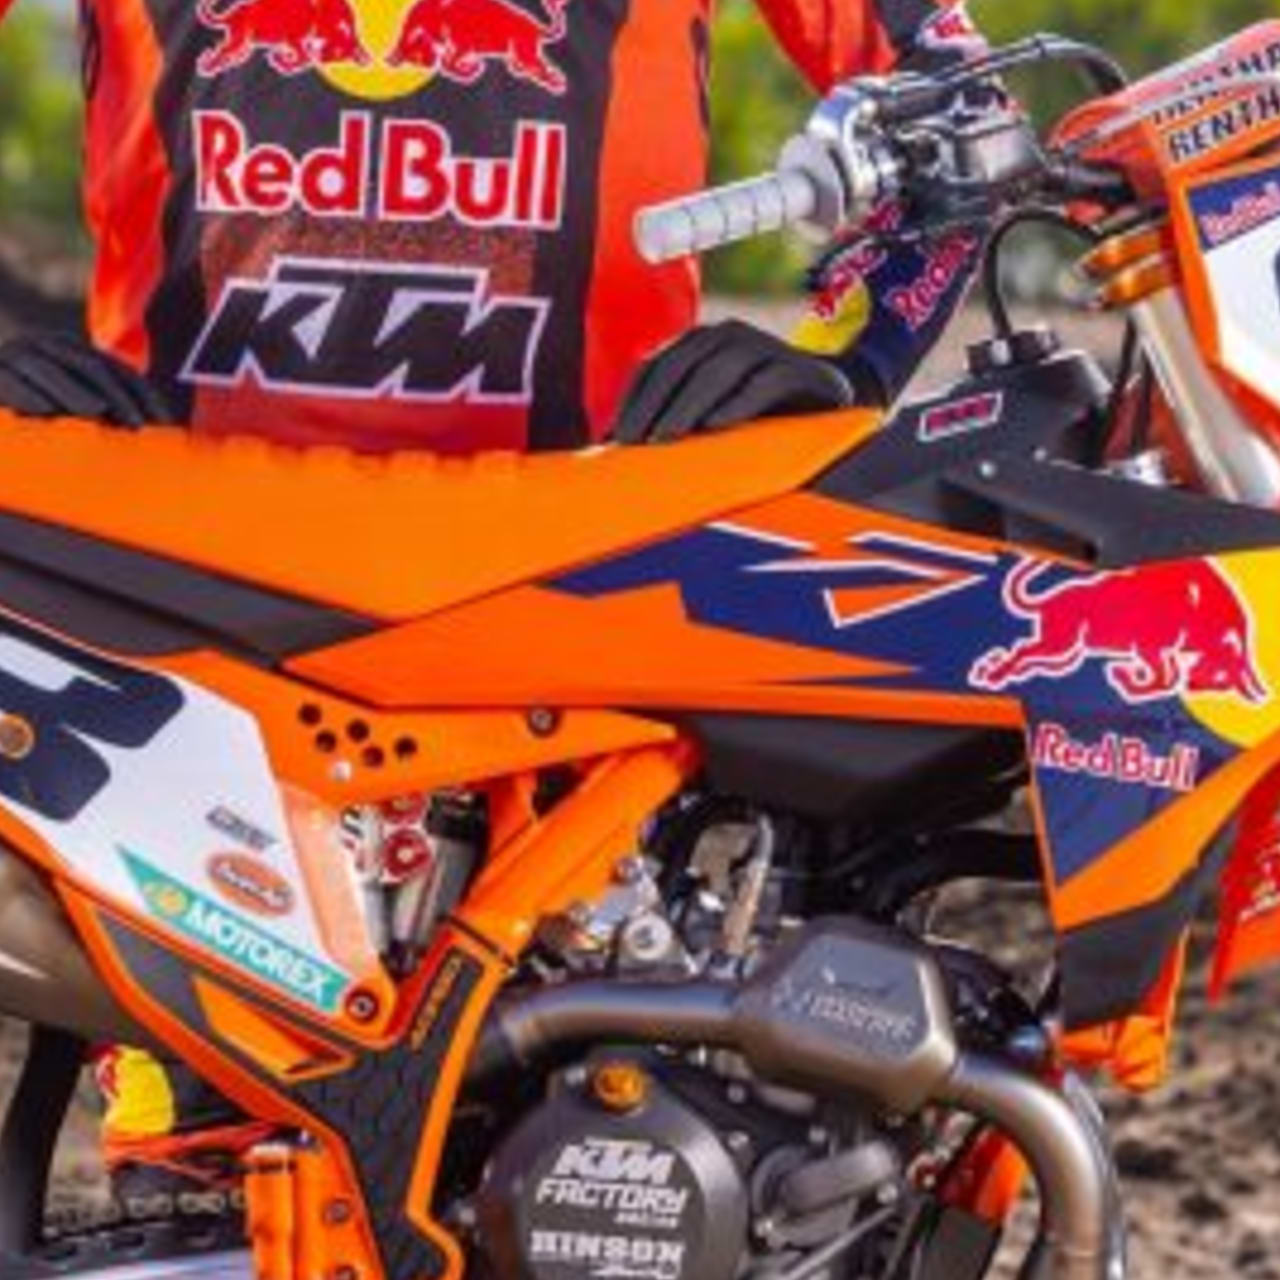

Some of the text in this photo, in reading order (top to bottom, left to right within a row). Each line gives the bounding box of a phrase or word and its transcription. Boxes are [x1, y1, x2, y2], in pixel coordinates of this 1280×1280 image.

[192, 109, 566, 229] Red Bull
[180, 256, 552, 404] KTM
[1034, 723, 1201, 791] Red Bull
[186, 898, 328, 1012] MOTOREX
[535, 1177, 690, 1216] FACTORY
[552, 1137, 677, 1185] KTM
